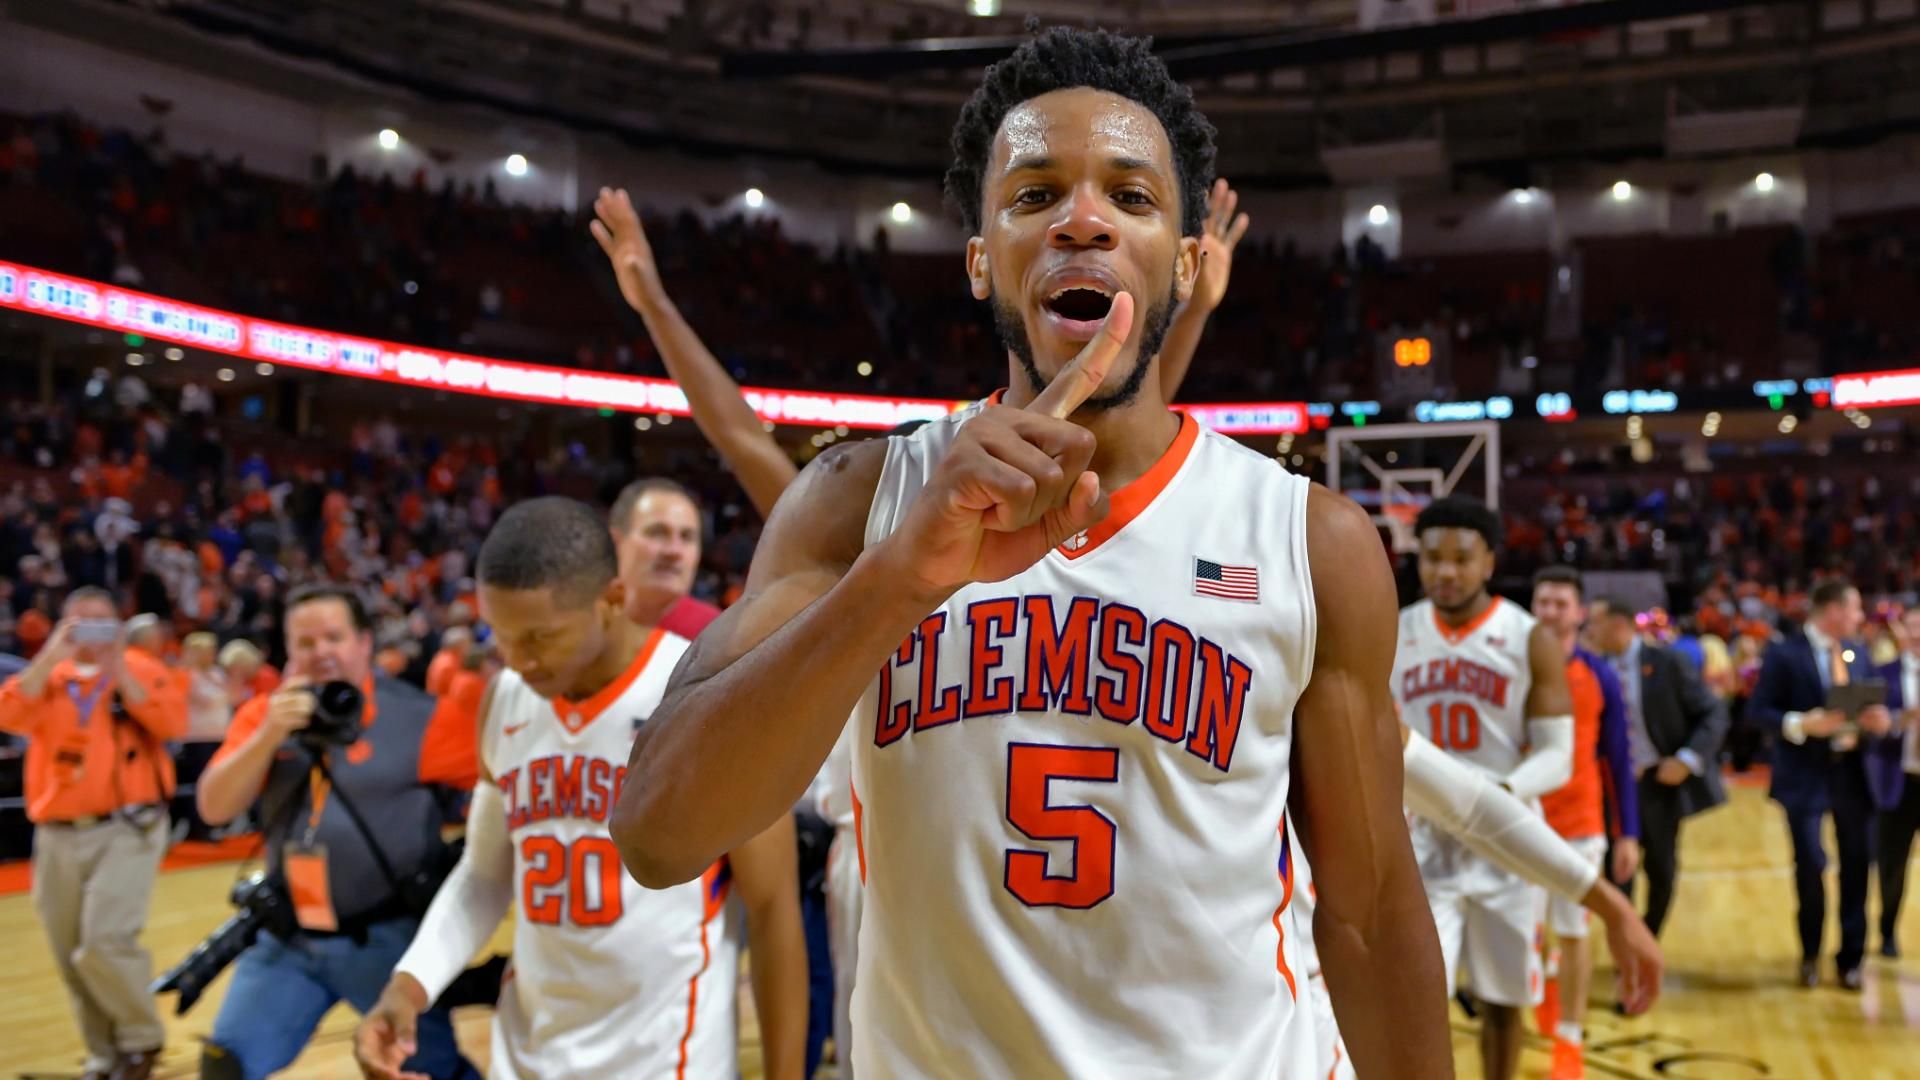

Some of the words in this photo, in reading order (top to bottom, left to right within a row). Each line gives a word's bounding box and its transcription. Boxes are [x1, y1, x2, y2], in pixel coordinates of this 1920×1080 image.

[874, 595, 1252, 773] CLEMSON
[1403, 657, 1511, 709] CLEMSON
[1427, 702, 1481, 751] 10
[1004, 742, 1119, 909] 5
[521, 835, 624, 927] 20
